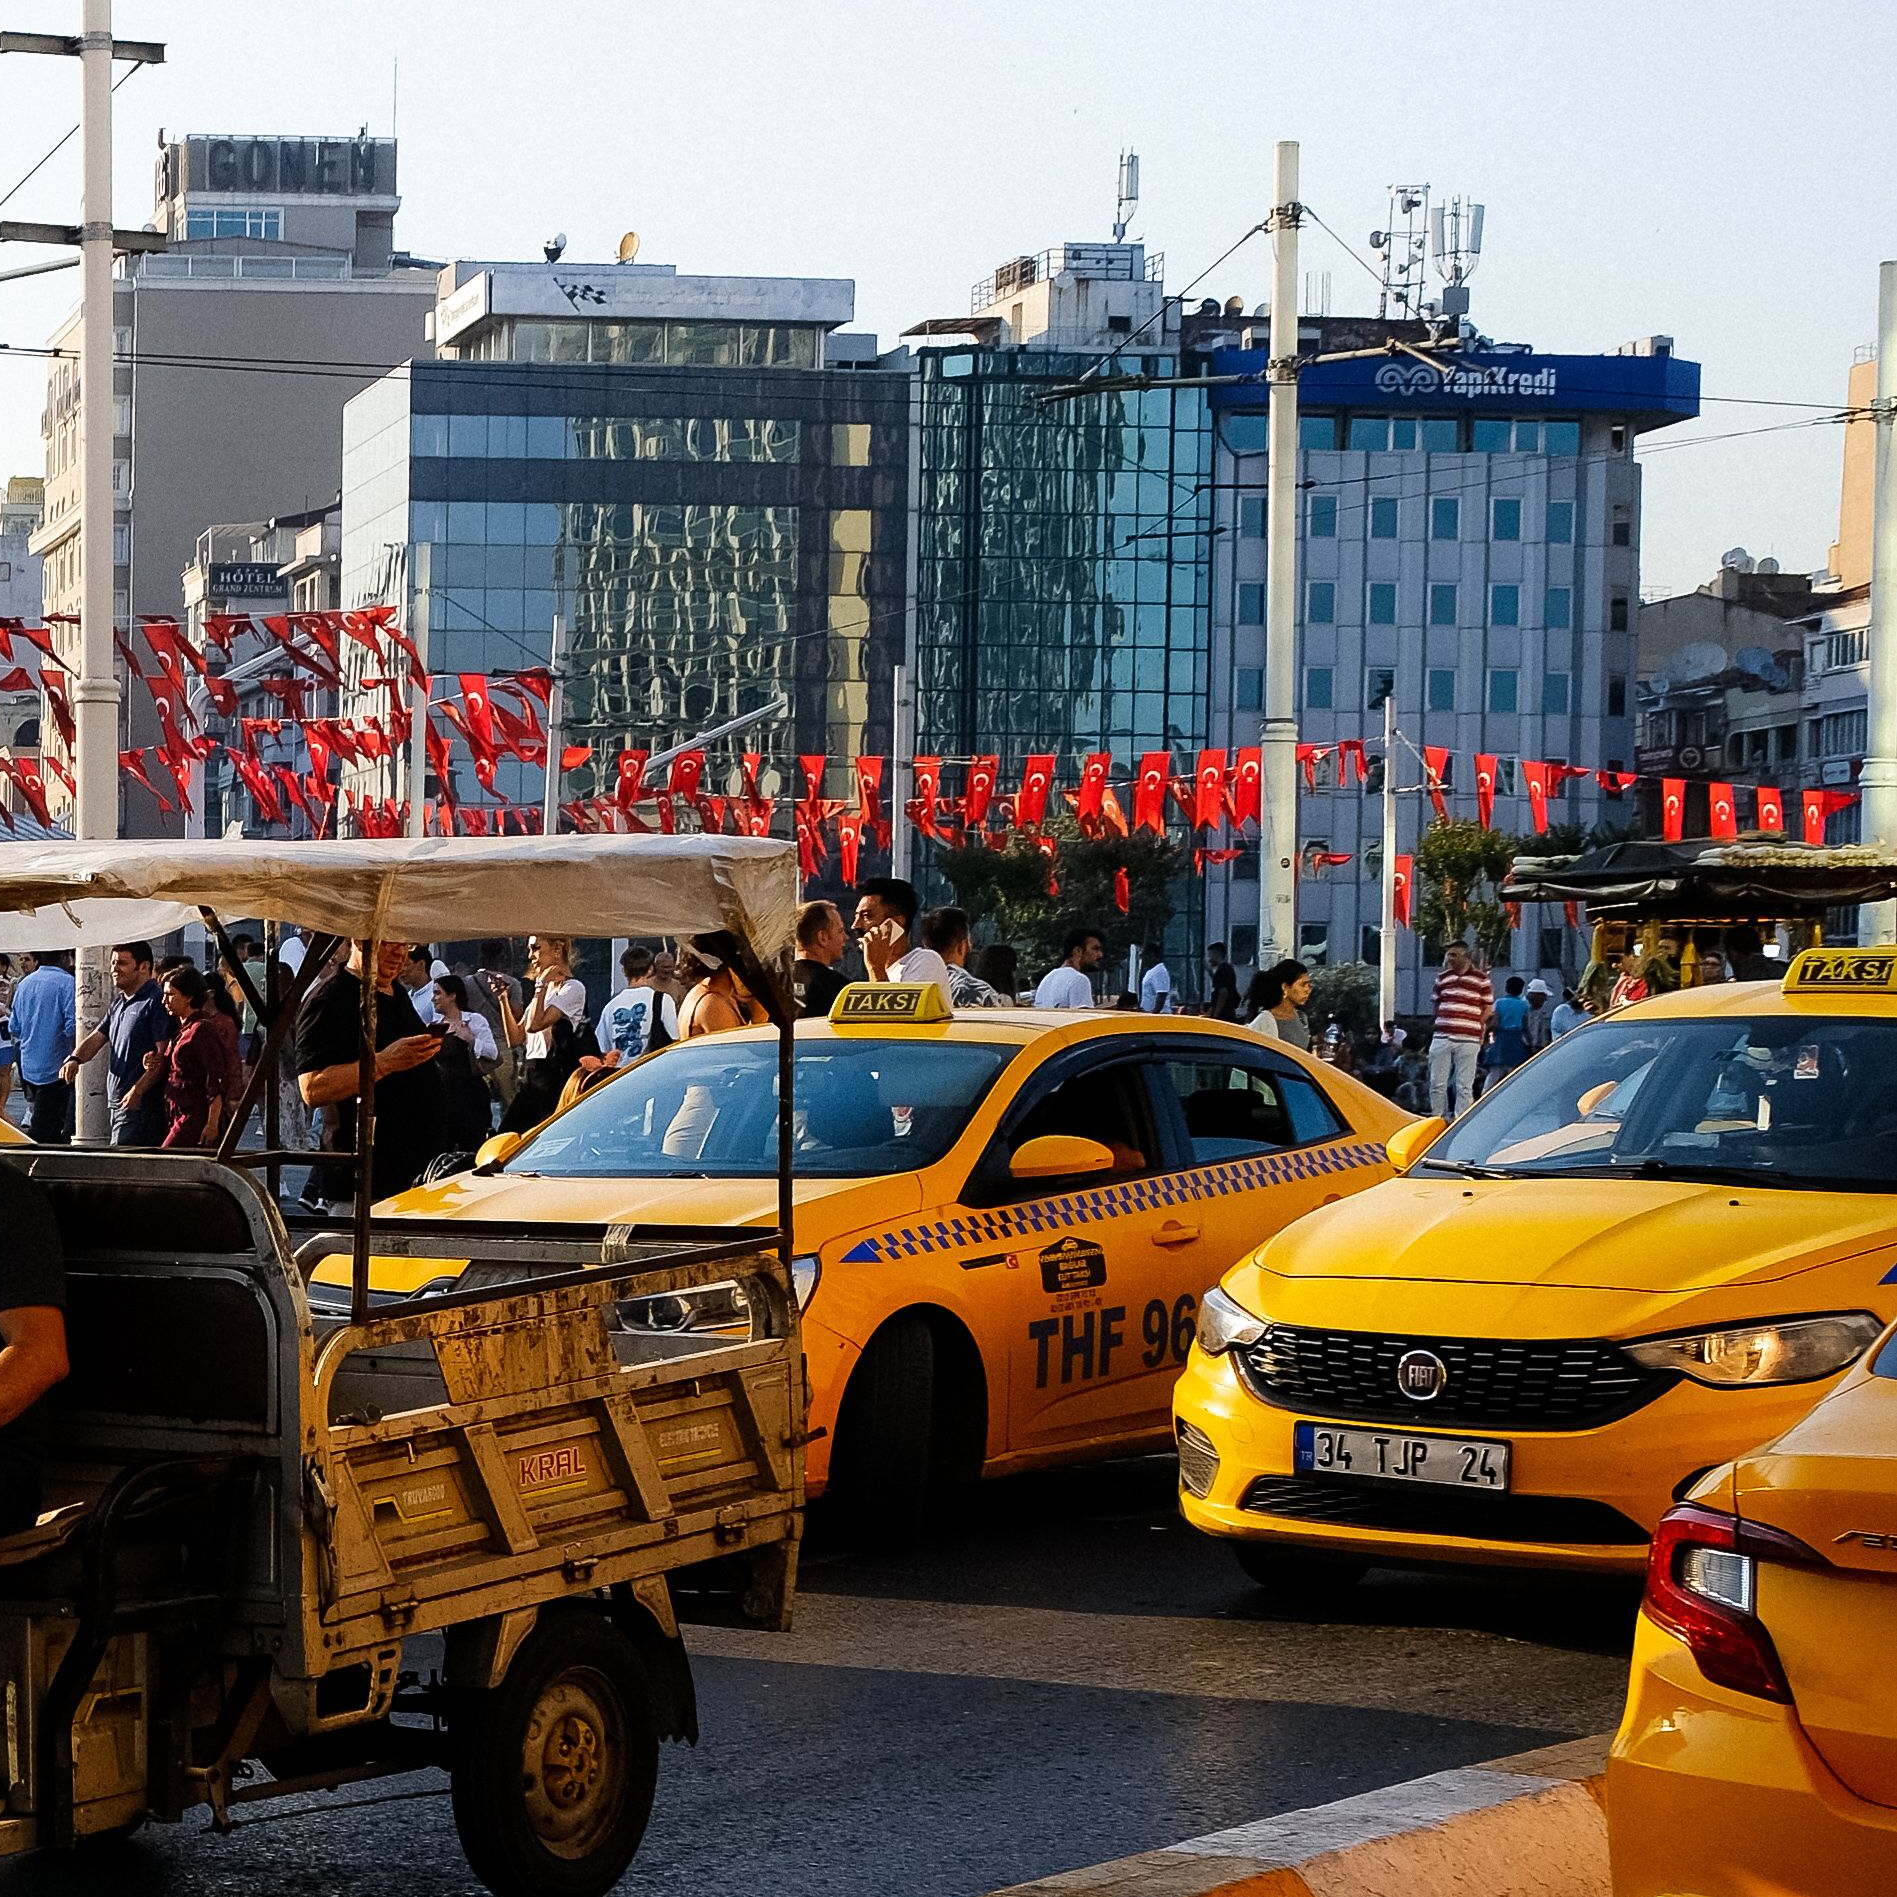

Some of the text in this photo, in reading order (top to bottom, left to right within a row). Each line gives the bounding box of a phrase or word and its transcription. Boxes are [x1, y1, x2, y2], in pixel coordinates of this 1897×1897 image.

[212, 584, 242, 594] GRAND
[220, 572, 276, 584] HOTEL
[1028, 1293, 1197, 1389] THF 96
[1408, 1365, 1436, 1388] FIAT
[519, 1446, 587, 1486] KRAL
[1316, 1431, 1353, 1470] 34
[1372, 1436, 1428, 1477] TJP
[1458, 1446, 1498, 1485] 24
